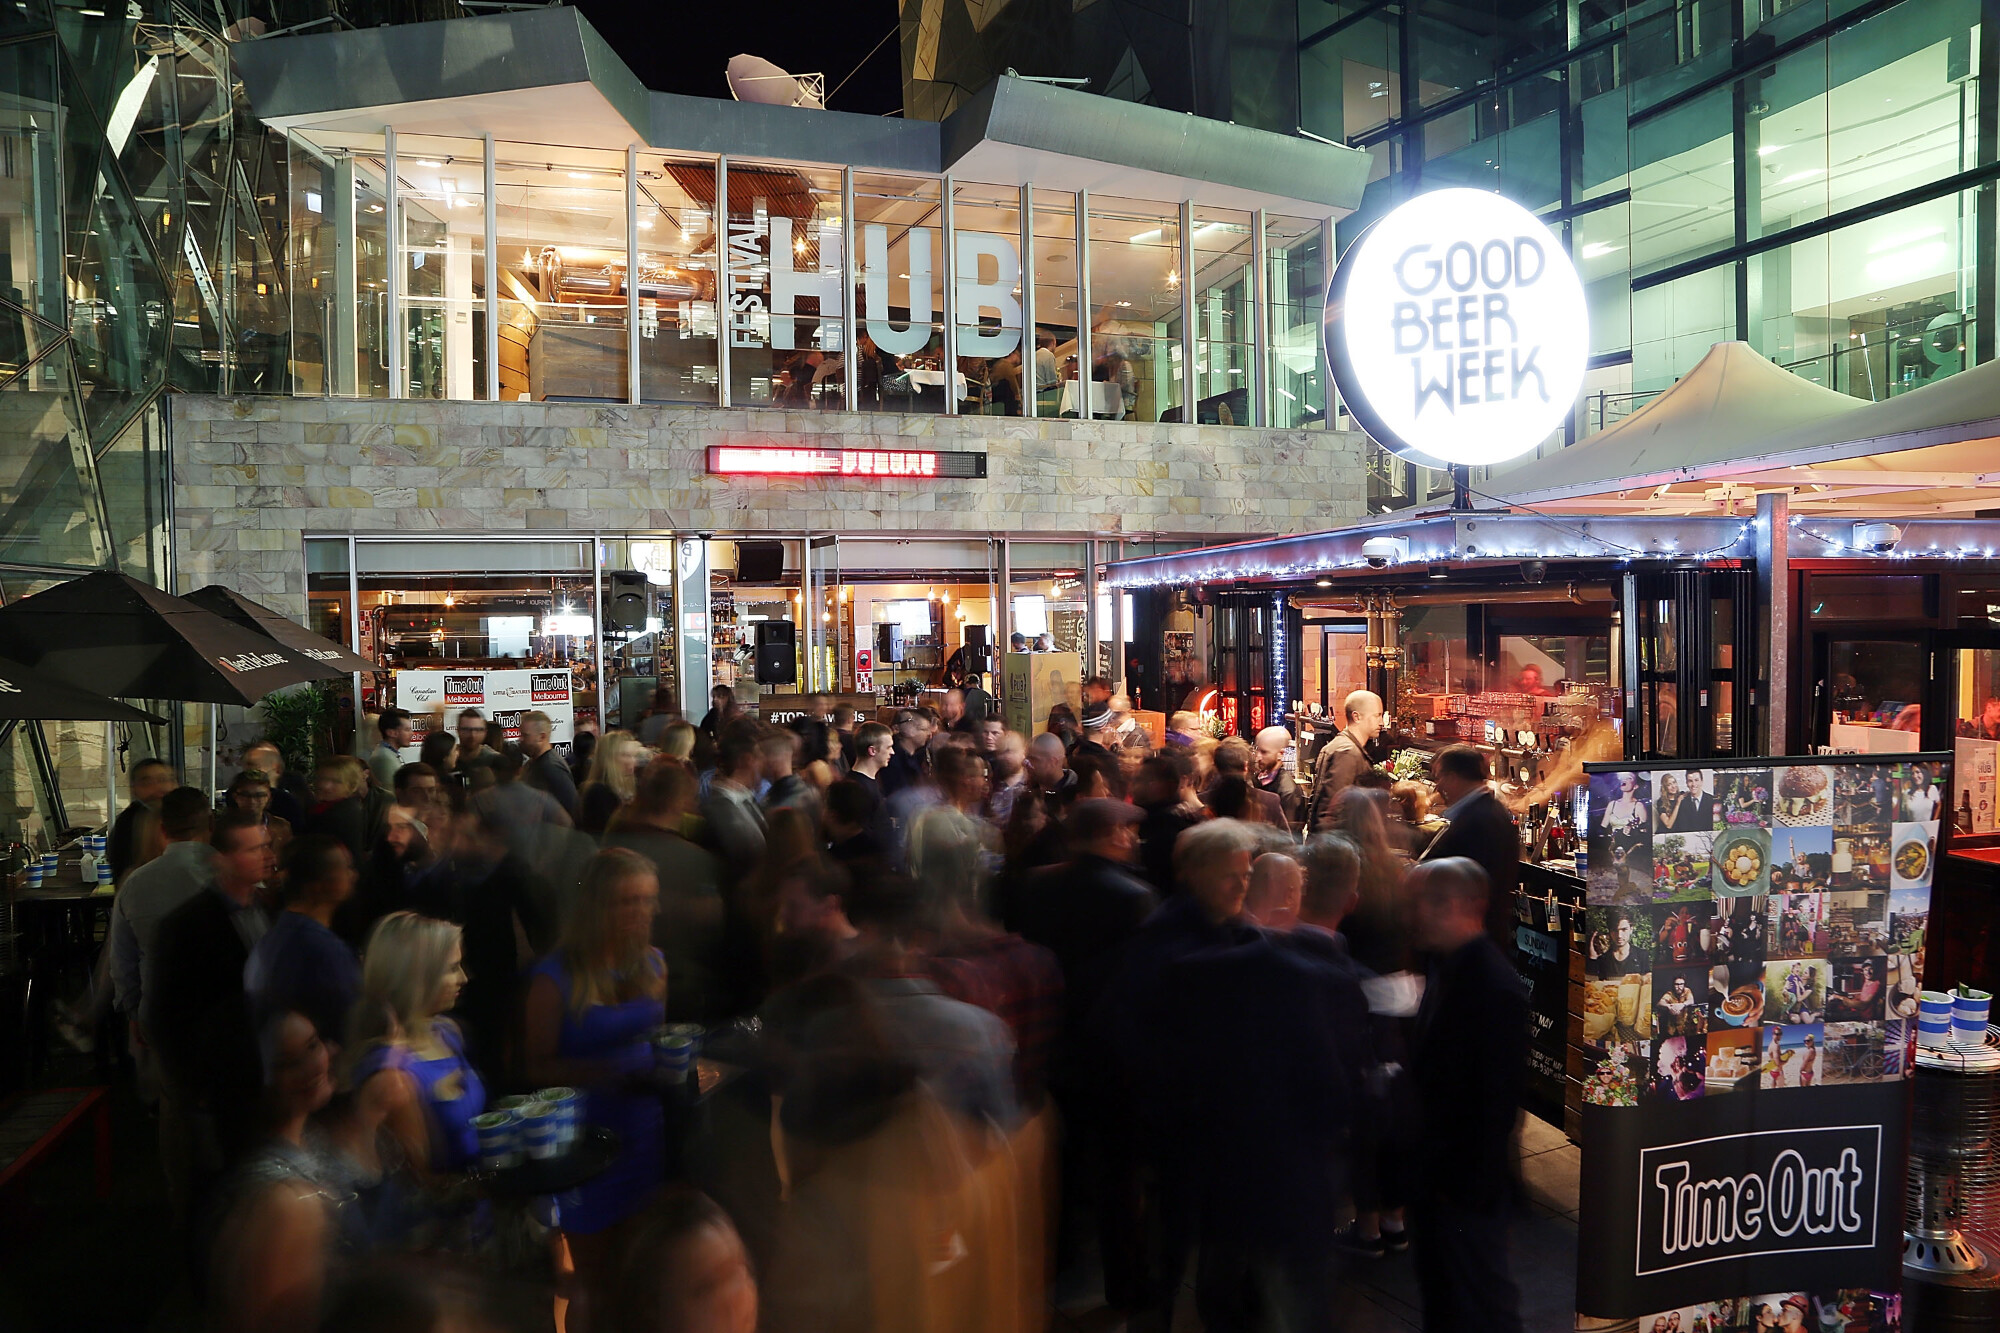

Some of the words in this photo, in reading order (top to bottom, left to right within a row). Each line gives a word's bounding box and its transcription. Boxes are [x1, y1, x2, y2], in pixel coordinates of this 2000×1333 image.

[728, 215, 763, 349] FESTIVAL
[770, 216, 1022, 358] HUB
[1392, 236, 1546, 297] GOOD
[1391, 292, 1518, 355] BEER
[1411, 345, 1551, 421] WEEK
[445, 677, 466, 694] Time
[466, 677, 485, 693] Out
[447, 695, 482, 703] Melbourne
[532, 675, 551, 692] Time
[551, 674, 568, 691] Out
[533, 692, 567, 700] Melbourne
[1656, 1161, 1765, 1255] Time
[1767, 1148, 1863, 1238] Out
